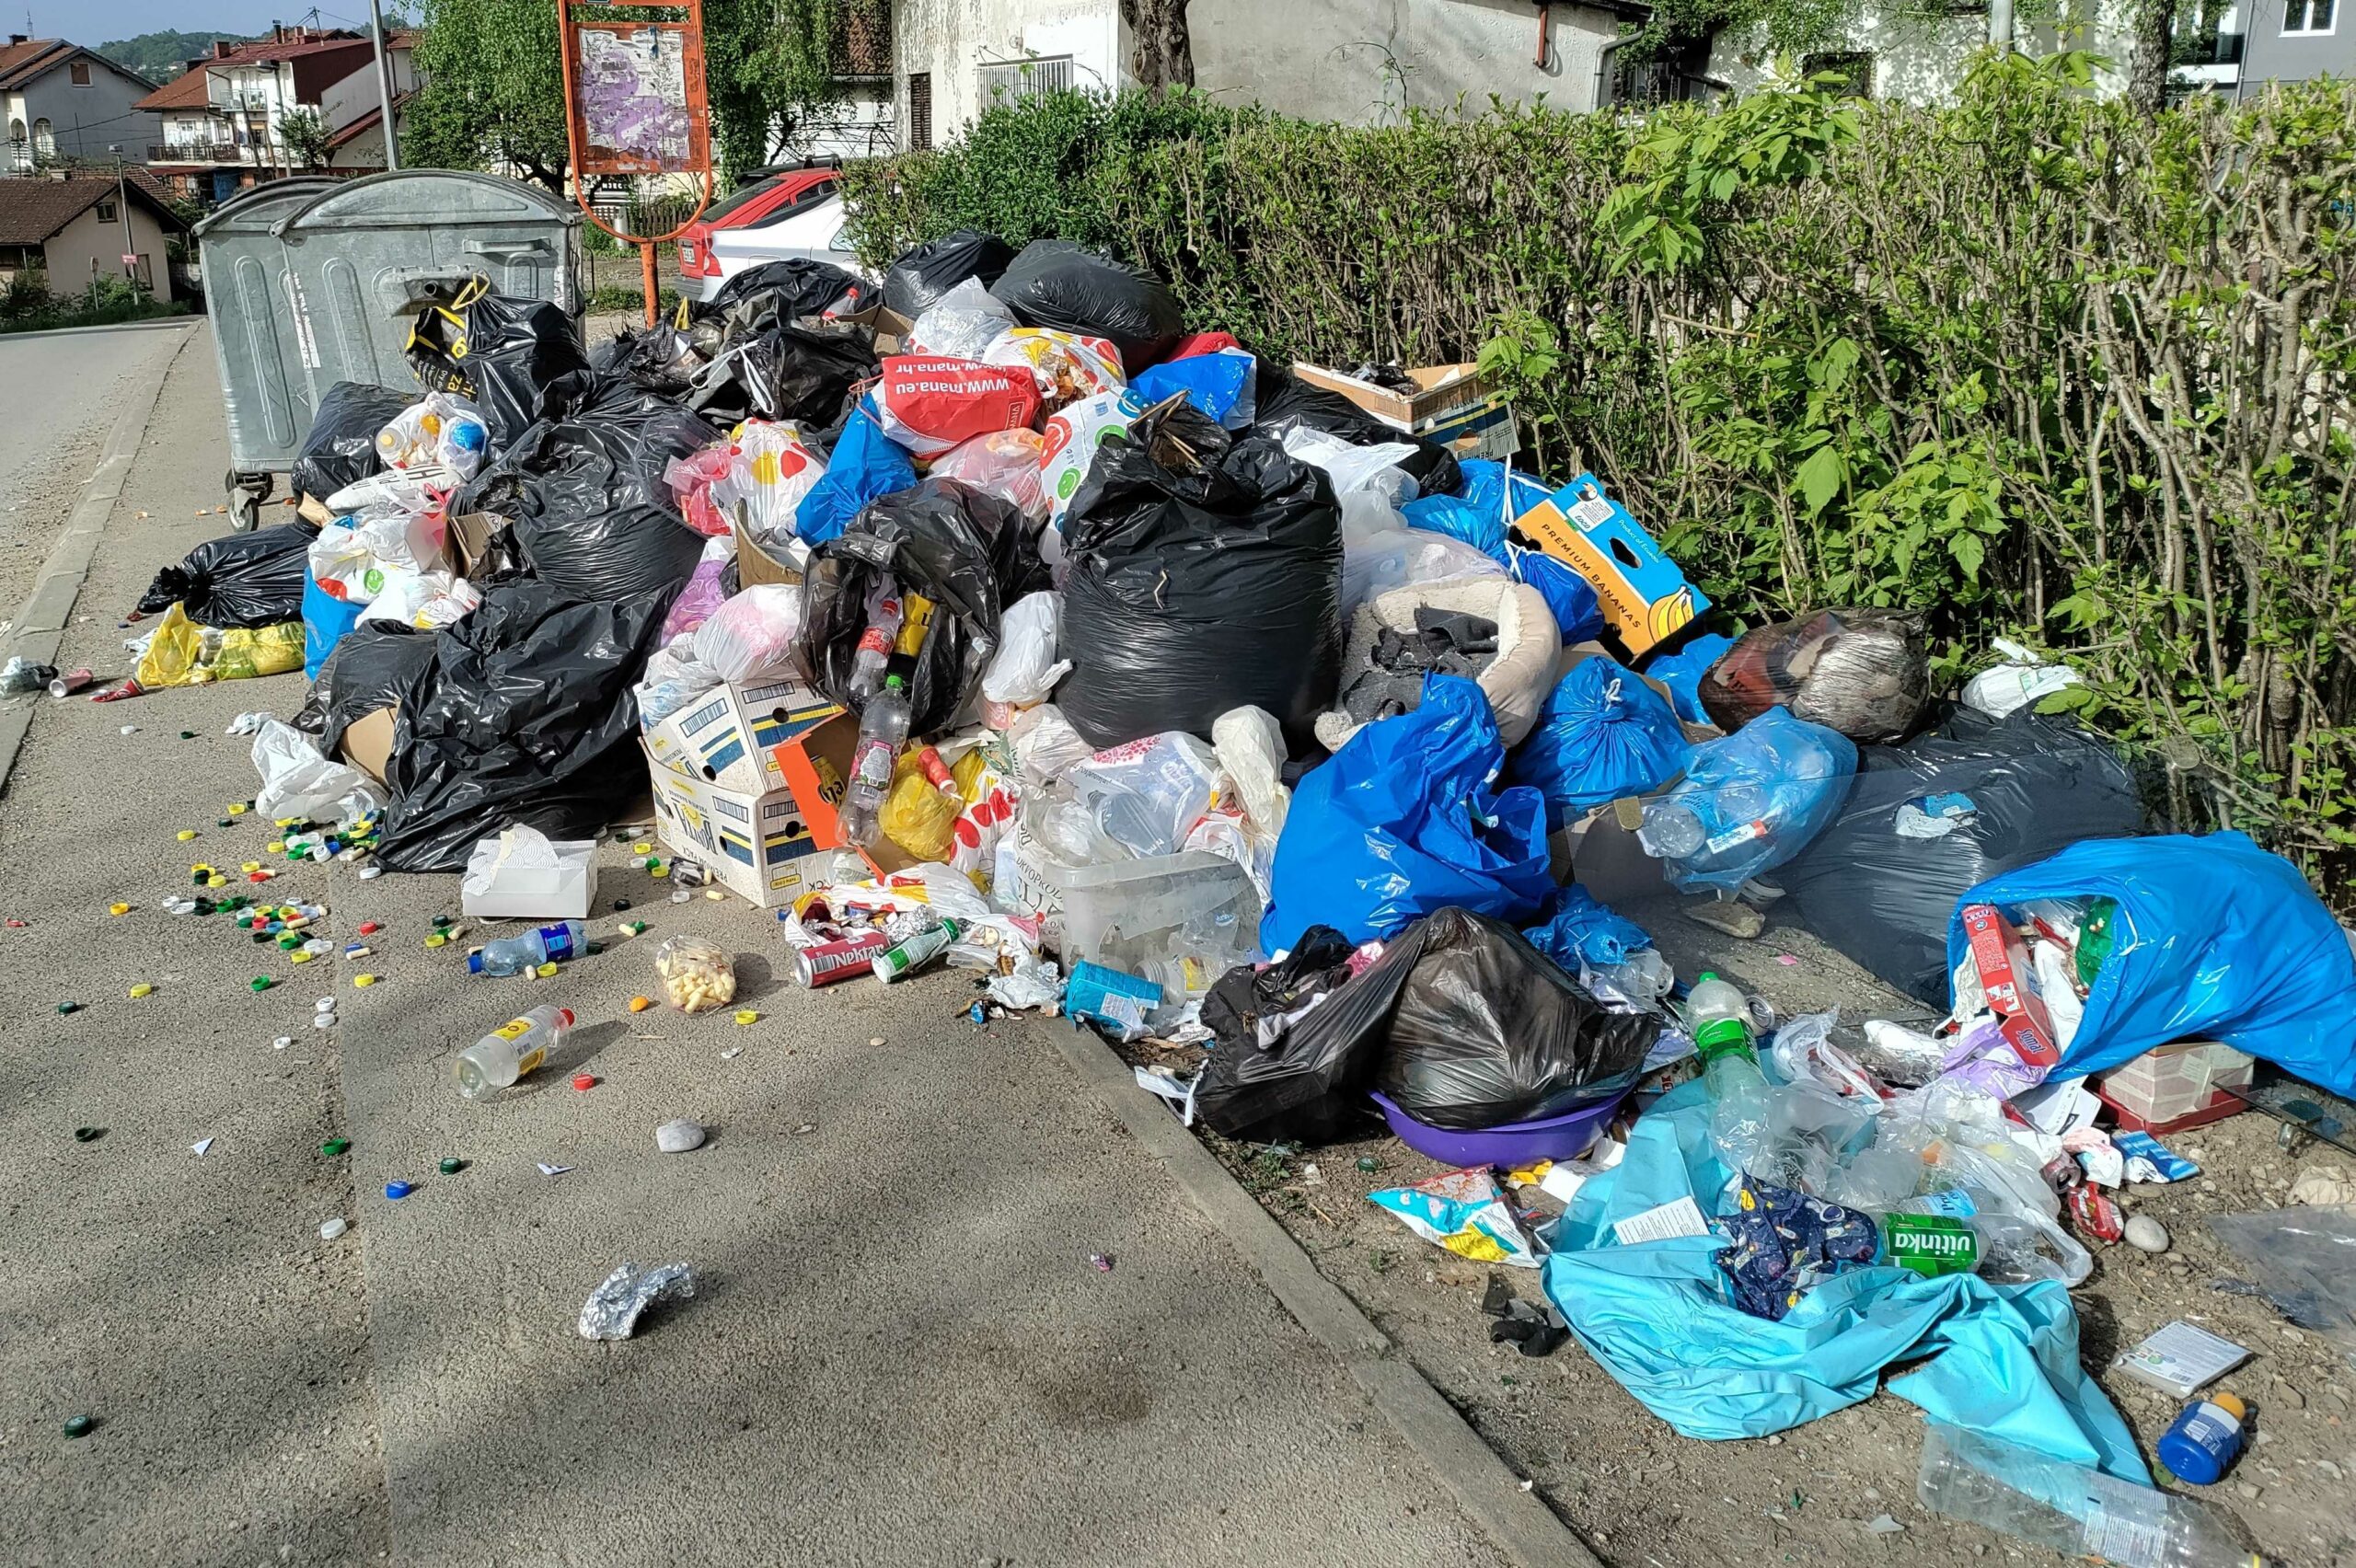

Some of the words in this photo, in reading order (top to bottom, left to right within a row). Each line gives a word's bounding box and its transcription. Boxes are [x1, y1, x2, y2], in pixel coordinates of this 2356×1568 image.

[895, 377, 1011, 395] www.mana.eu
[1618, 520, 1636, 541] Product
[1542, 524, 1591, 571] PREMIUM
[1591, 573, 1641, 628] BANANAS
[809, 879, 826, 892] CK
[834, 943, 884, 967] Nektar
[2017, 1028, 2047, 1054] Somat
